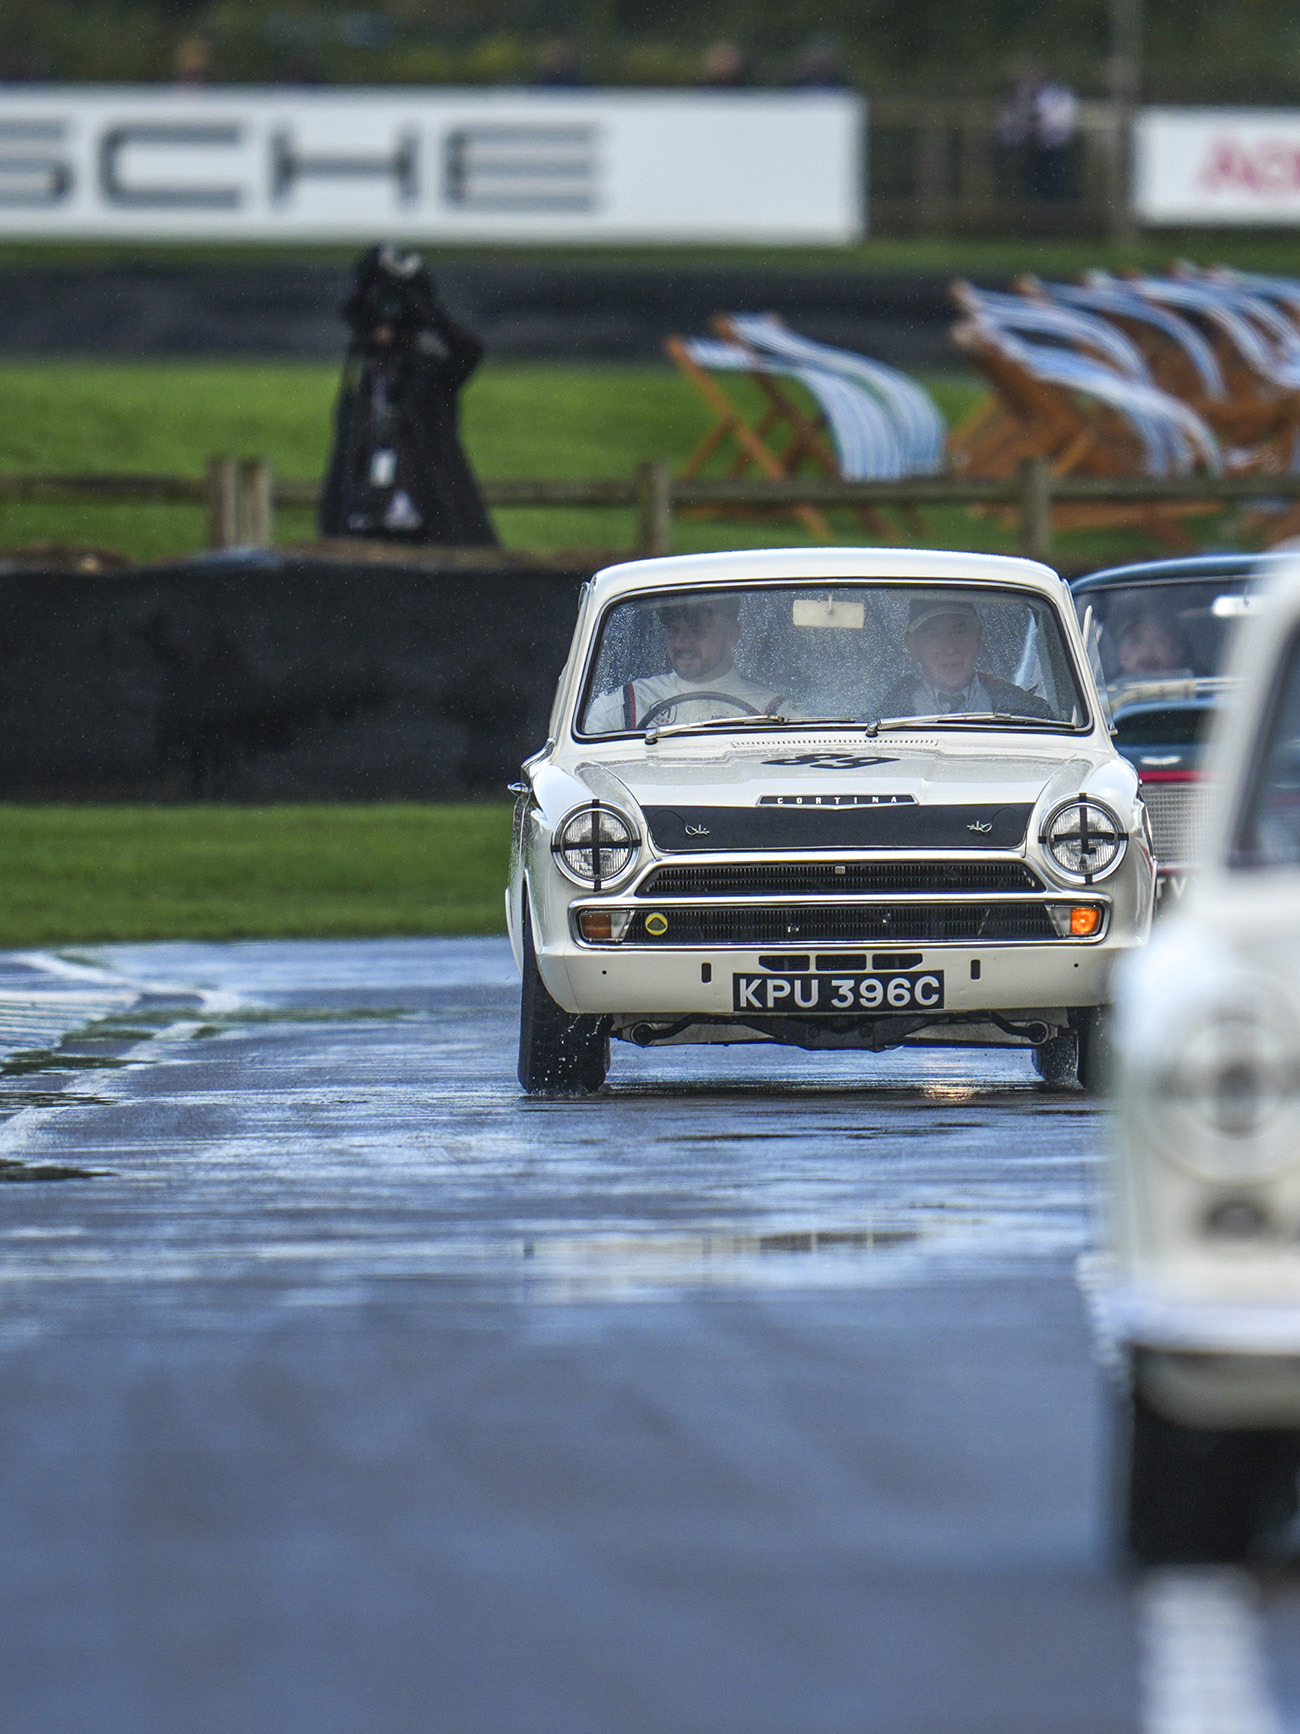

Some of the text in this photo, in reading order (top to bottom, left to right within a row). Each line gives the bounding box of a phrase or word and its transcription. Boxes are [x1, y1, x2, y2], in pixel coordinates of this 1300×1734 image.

[761, 752, 900, 770] 89
[777, 795, 897, 805] CORTINA
[739, 974, 940, 1009] KPU 396C
